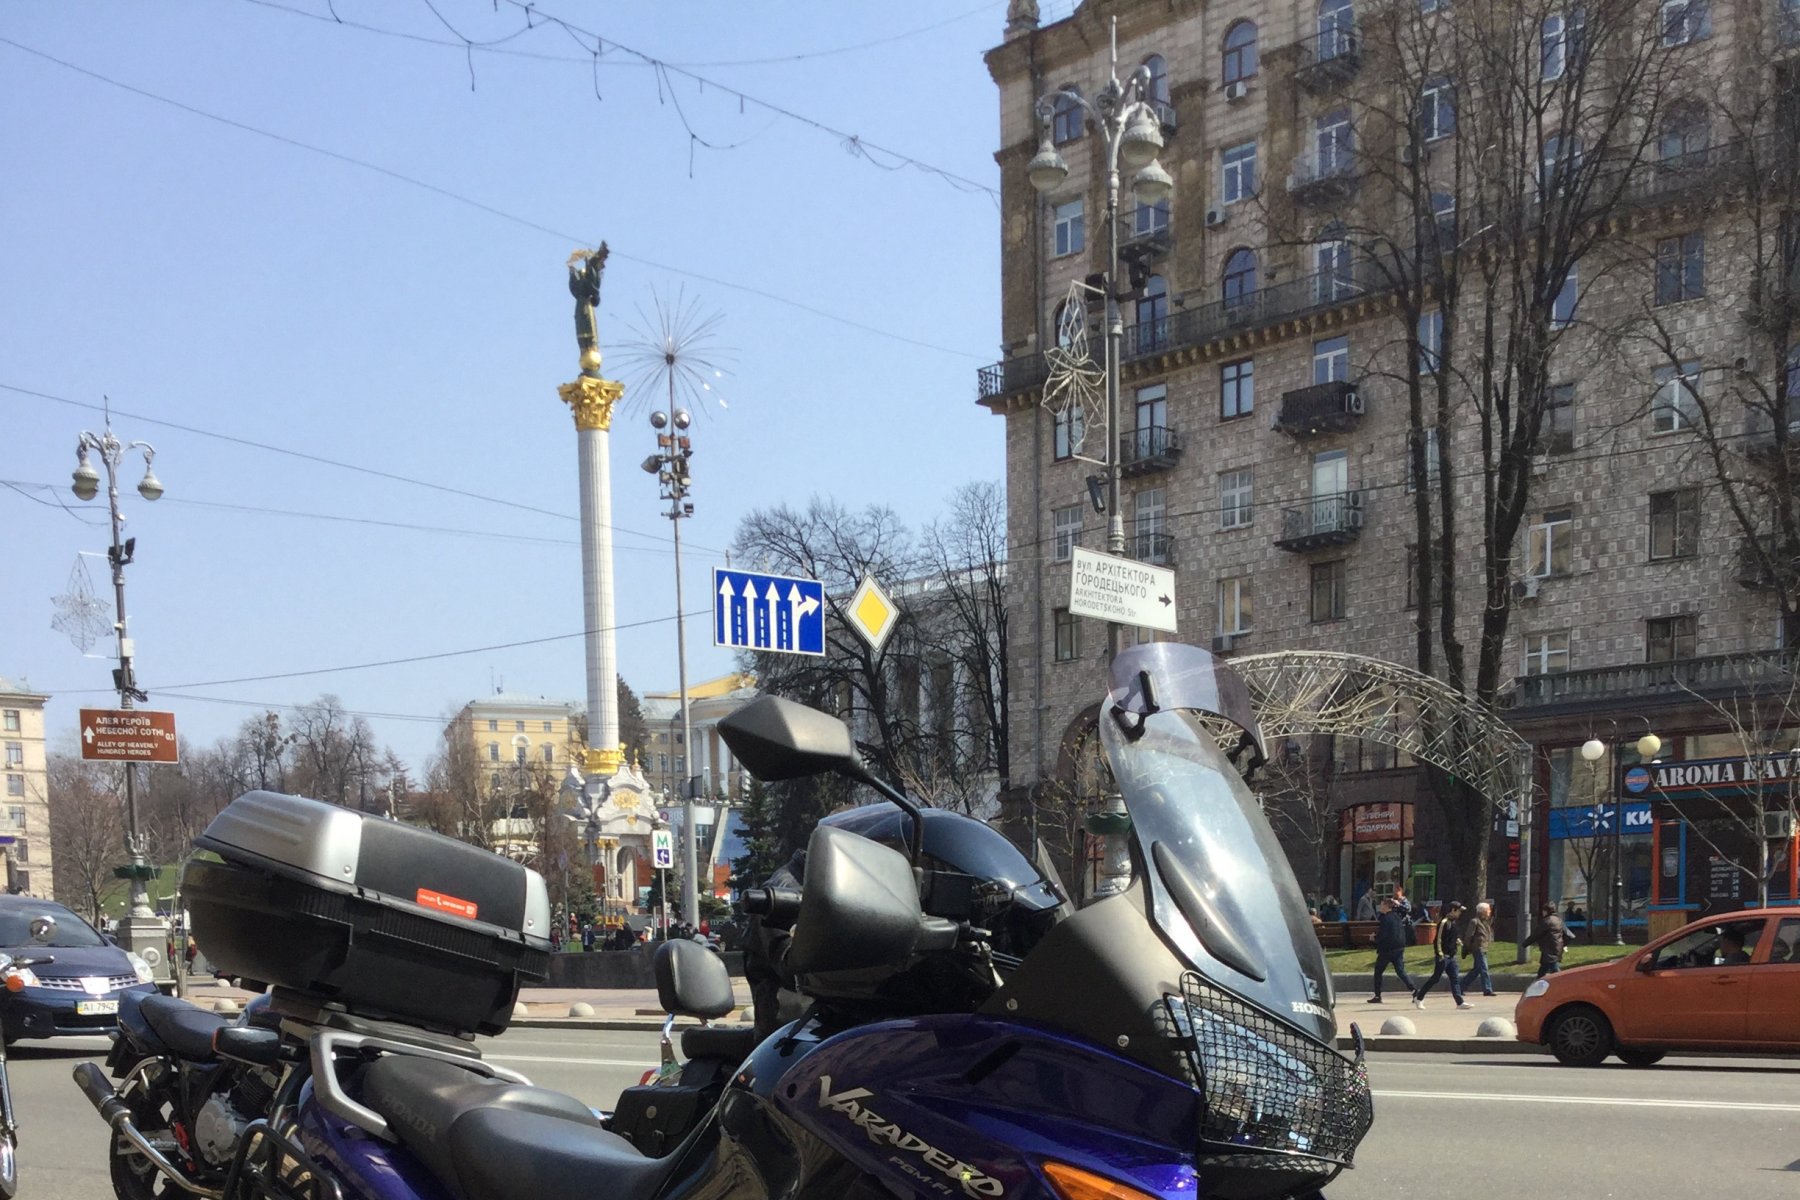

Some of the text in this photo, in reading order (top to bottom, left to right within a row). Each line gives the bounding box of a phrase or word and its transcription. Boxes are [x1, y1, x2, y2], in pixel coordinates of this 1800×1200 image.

[1096, 562, 1156, 585] АРХІТЕКТОРА
[1075, 587, 1123, 604] ARKHITEKTORA
[1076, 572, 1147, 599] ГОРОДЕЦЬКОГО
[1074, 599, 1126, 616] HORODETSKOHO
[96, 716, 151, 726] АЛЕЯ ГЕРОЇВ
[96, 726, 164, 737] НЕБЕСНОЇ СОТНІ
[1655, 763, 1737, 787] AROMA
[1292, 1001, 1332, 1022] HONDA
[819, 1075, 1004, 1200] VARADERO
